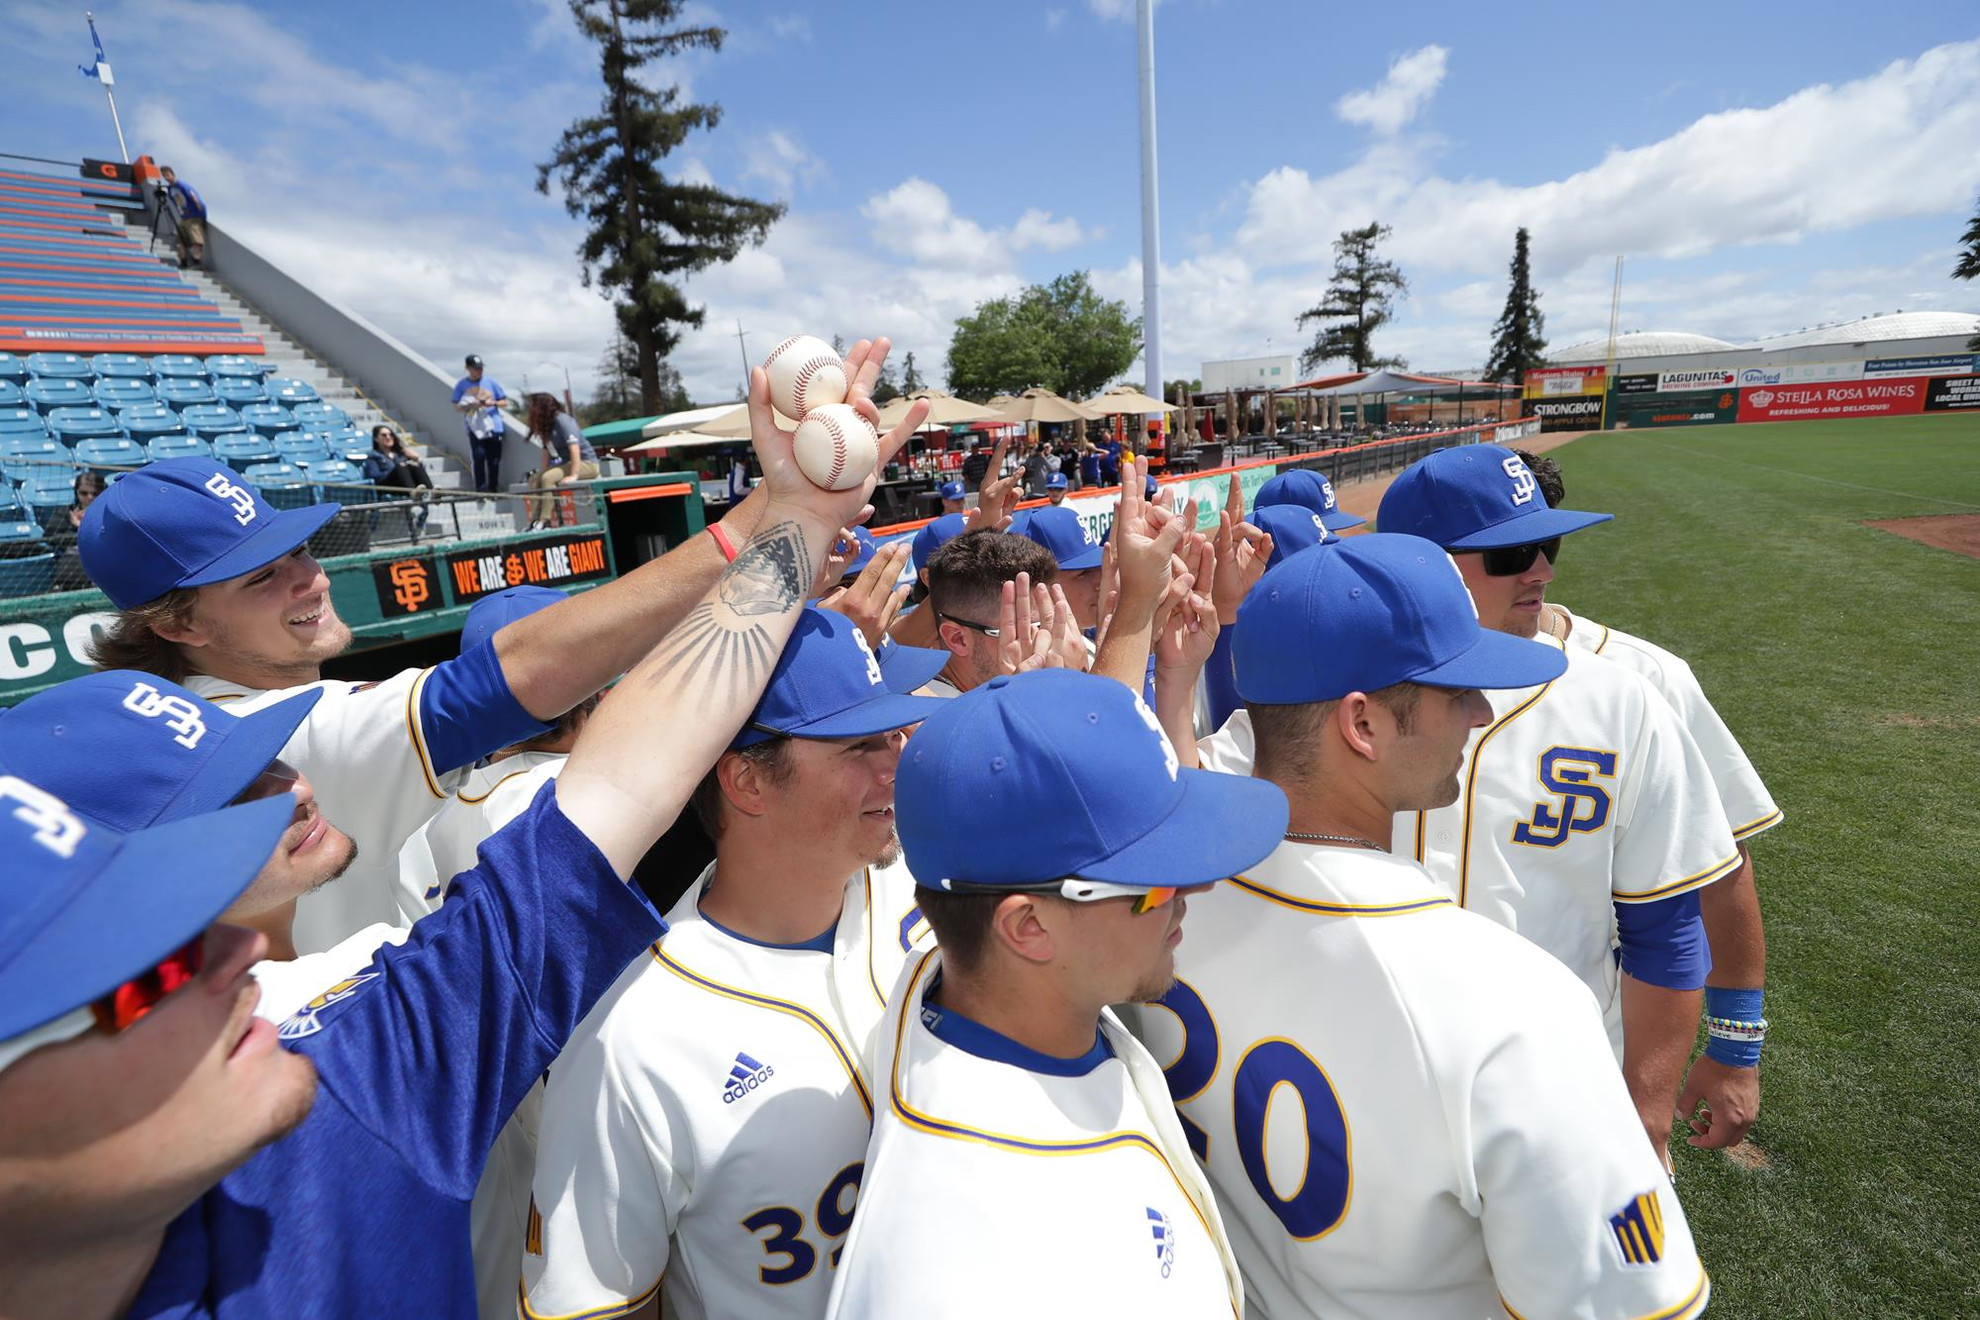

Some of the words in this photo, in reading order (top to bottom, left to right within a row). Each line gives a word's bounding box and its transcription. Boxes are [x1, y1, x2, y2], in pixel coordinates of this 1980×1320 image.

[1662, 371, 1728, 383] LAGUNITAS
[1745, 372, 1781, 382] United
[1777, 391, 1822, 404] STELLA
[1827, 388, 1863, 401] ROSA
[1867, 384, 1915, 398] WINES
[1934, 394, 1961, 402] LOCAL
[1534, 402, 1602, 416] STRONGBOW
[1769, 407, 1819, 416] REFRESHING
[453, 559, 481, 596] WE
[479, 555, 507, 592] ARE
[523, 549, 548, 582] WE
[545, 545, 571, 580] ARE
[568, 540, 605, 575] GIANT
[722, 1063, 775, 1104] adidas
[739, 1160, 866, 1286] 39
